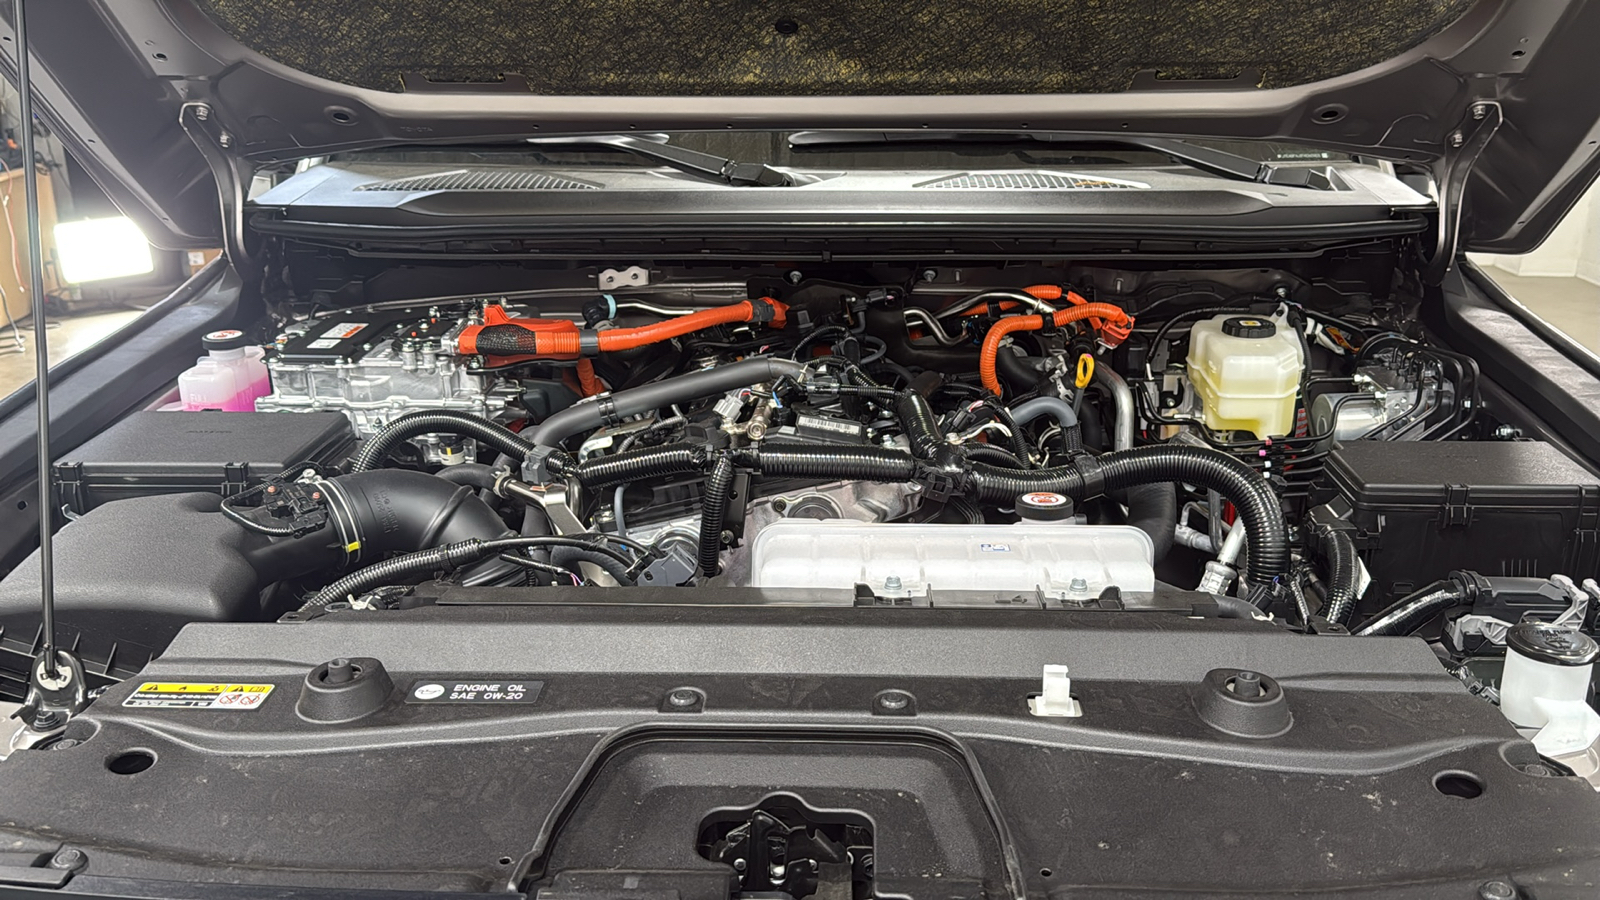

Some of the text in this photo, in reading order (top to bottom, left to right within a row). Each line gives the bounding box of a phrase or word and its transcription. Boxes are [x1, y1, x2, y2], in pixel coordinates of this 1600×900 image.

[453, 684, 527, 692] ENGINE OIL
[449, 692, 524, 700] SAE 0W-20
